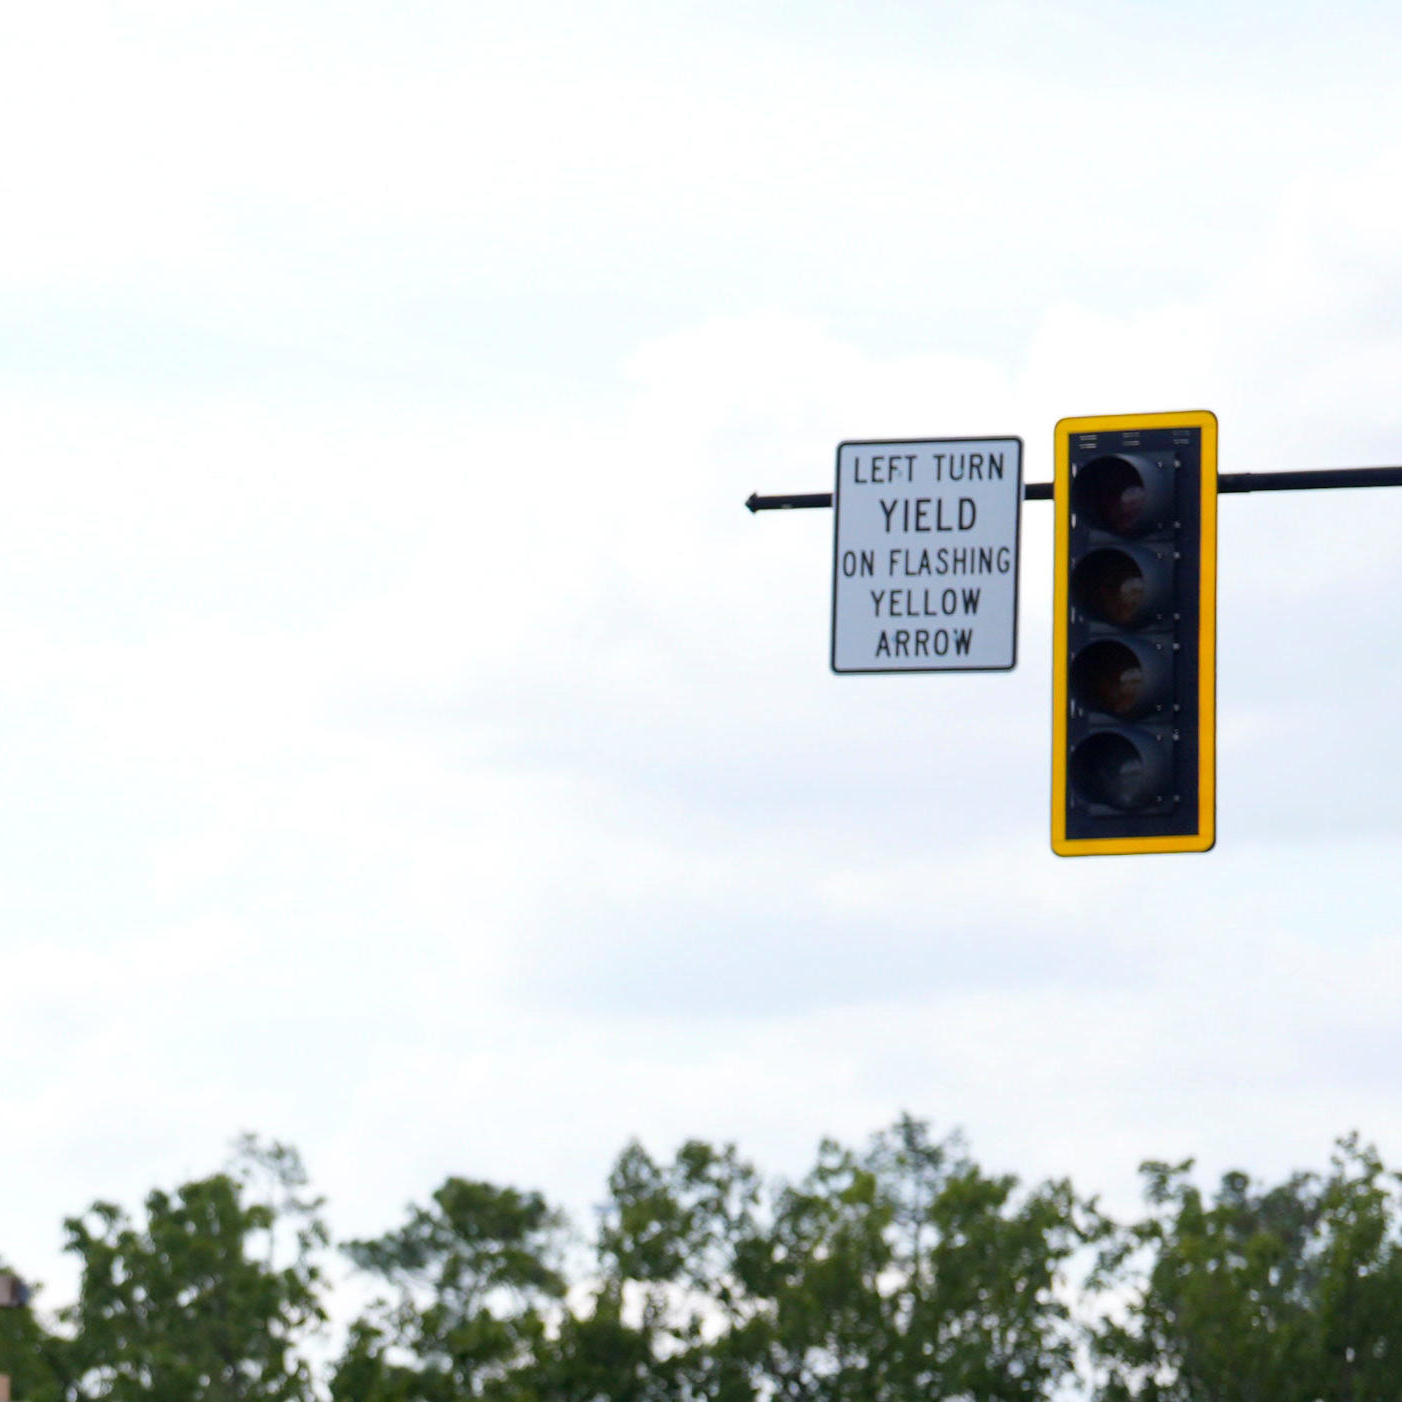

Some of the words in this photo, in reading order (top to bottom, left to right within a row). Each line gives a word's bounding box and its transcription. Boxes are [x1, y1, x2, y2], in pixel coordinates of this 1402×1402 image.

[853, 455, 918, 484] LEFT
[933, 452, 1005, 481] TURN
[879, 497, 977, 533] YIELD
[842, 550, 875, 577] ON
[889, 546, 1011, 577] FLASHING
[870, 587, 981, 617] YELLOW
[874, 628, 973, 658] ARROW
